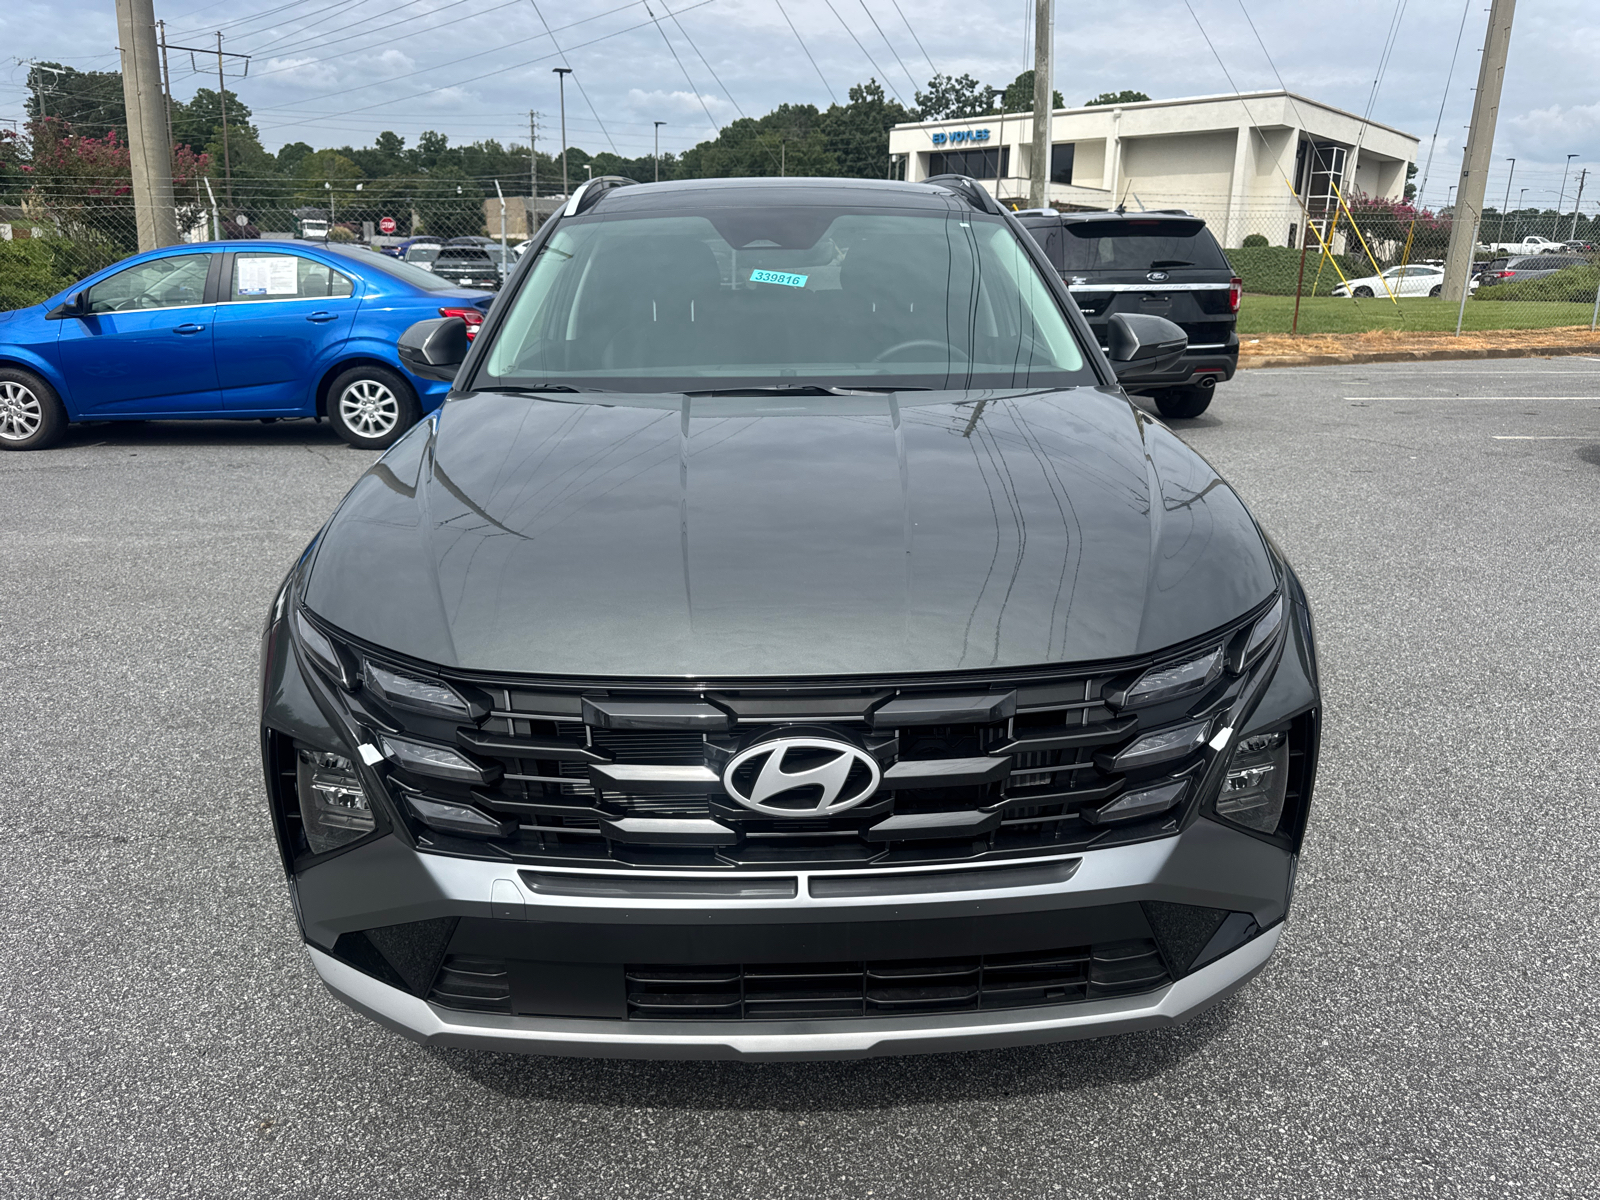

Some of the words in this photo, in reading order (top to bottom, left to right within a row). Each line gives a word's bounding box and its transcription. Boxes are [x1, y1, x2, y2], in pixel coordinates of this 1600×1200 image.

[932, 133, 947, 144] ED
[948, 128, 991, 142] VOYLES
[381, 221, 395, 229] STOP
[755, 271, 801, 285] 339816
